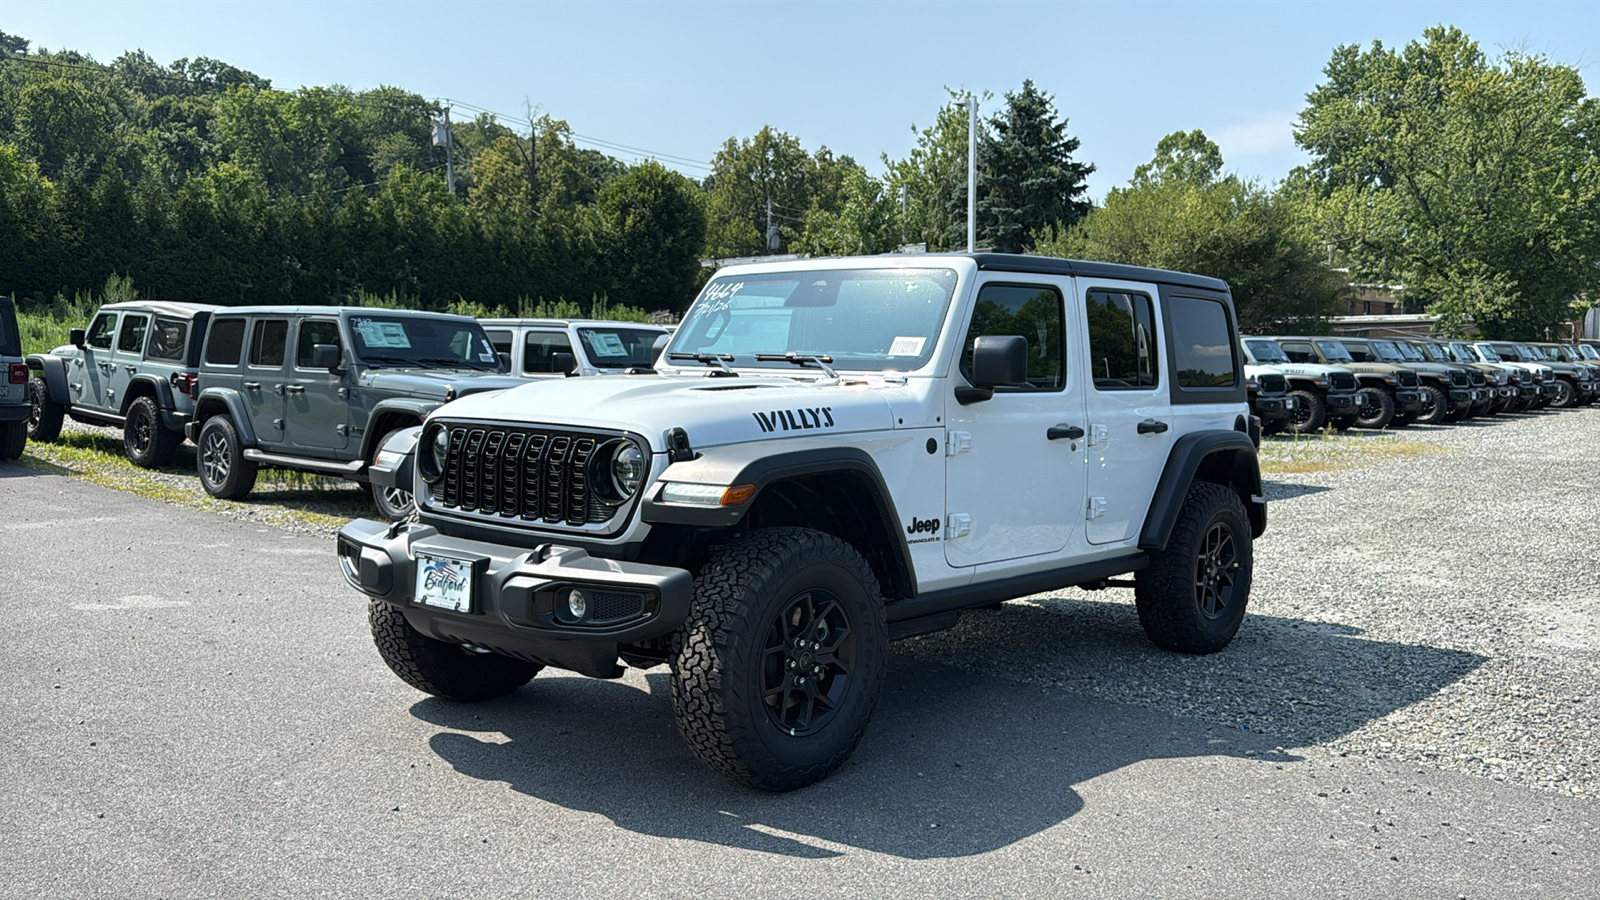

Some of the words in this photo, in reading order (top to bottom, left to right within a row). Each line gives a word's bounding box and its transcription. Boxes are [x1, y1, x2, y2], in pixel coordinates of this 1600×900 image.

[752, 406, 835, 433] WILLYS
[907, 516, 940, 535] Jeep
[424, 568, 467, 596] Bedford
